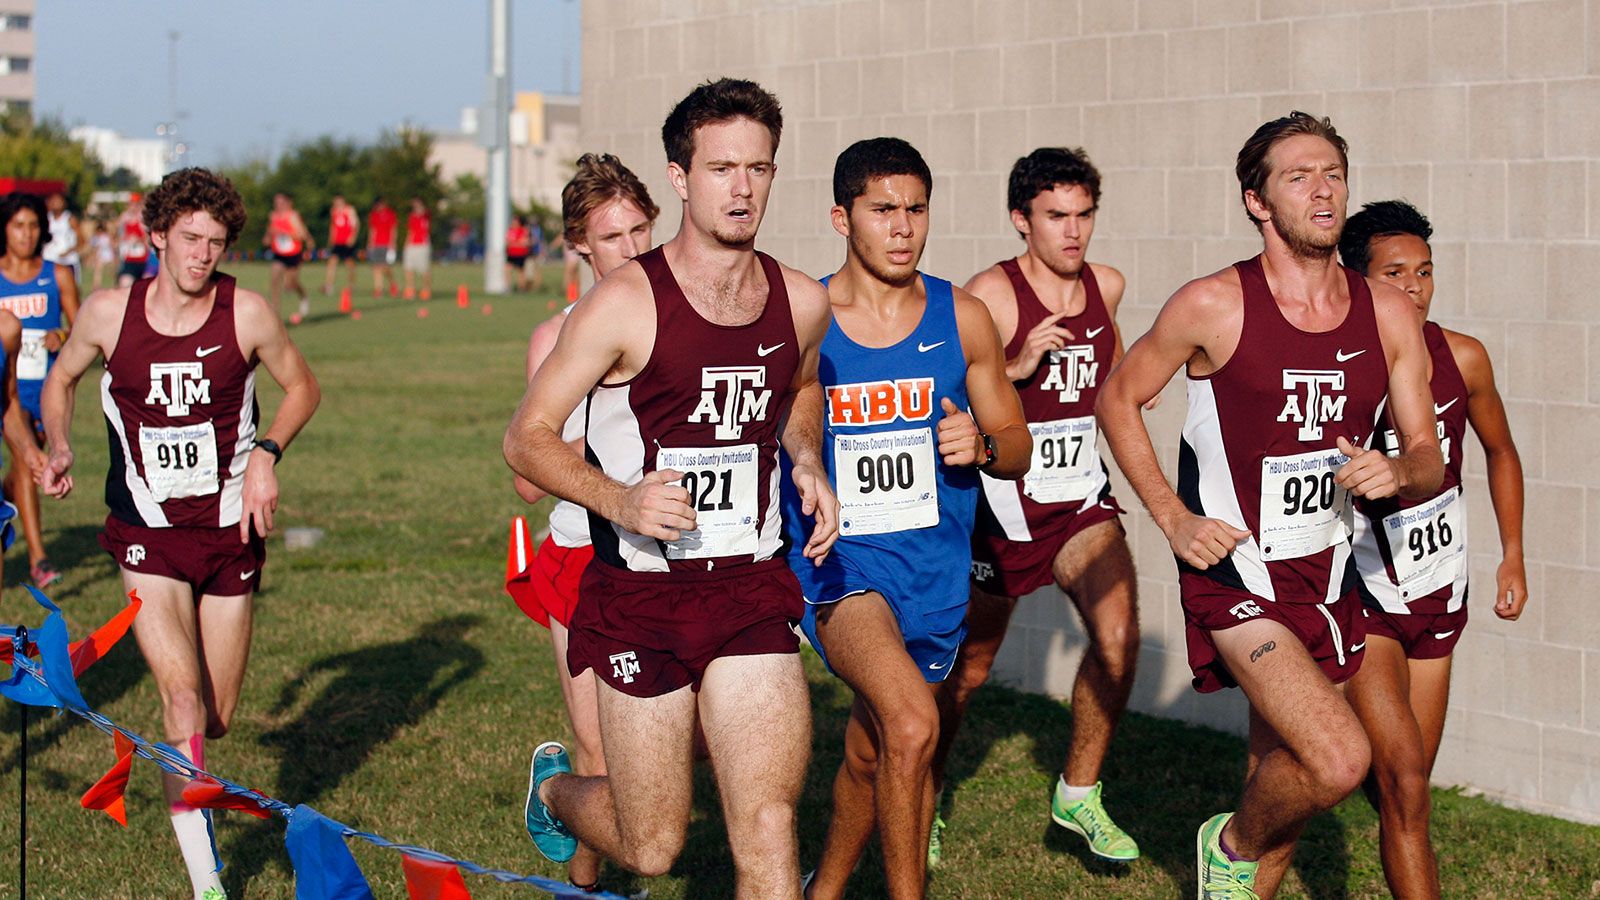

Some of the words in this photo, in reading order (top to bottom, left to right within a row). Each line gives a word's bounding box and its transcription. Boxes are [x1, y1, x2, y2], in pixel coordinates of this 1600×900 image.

[825, 377, 934, 427] HBU
[157, 441, 199, 470] 918
[853, 438, 869, 451] Cross
[870, 437, 893, 450] Country
[894, 432, 927, 447] Invitational
[1040, 435, 1083, 469] 917
[663, 453, 677, 466] HBU
[679, 453, 696, 466] Cross
[697, 452, 721, 467] Country
[721, 449, 753, 465] Invitational
[857, 451, 914, 494] 900
[1269, 461, 1282, 474] HBU
[1283, 461, 1299, 473] Cross
[1300, 458, 1321, 470] Country
[1283, 471, 1336, 516] 920
[1401, 513, 1417, 526] Cross
[1417, 506, 1436, 521] Country
[1408, 512, 1453, 562] 916
